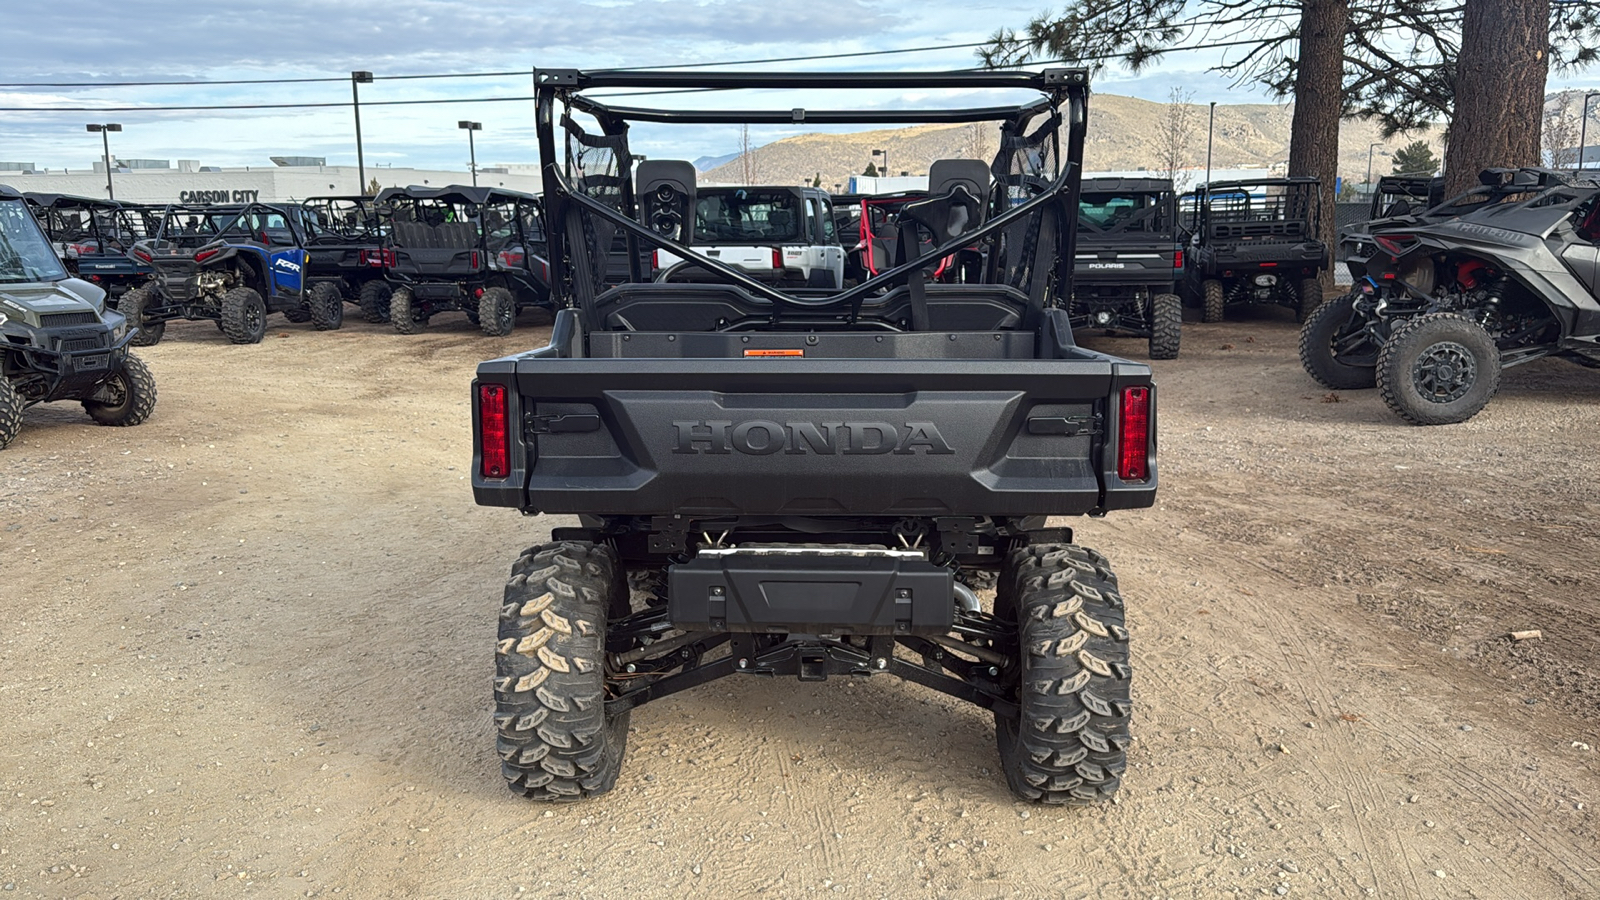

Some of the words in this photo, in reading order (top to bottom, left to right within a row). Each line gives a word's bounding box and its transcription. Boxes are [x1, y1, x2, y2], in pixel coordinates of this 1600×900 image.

[180, 190, 230, 203] CARSON
[232, 190, 259, 203] CITY
[275, 258, 300, 272] RZR
[671, 419, 956, 456] HONDA
